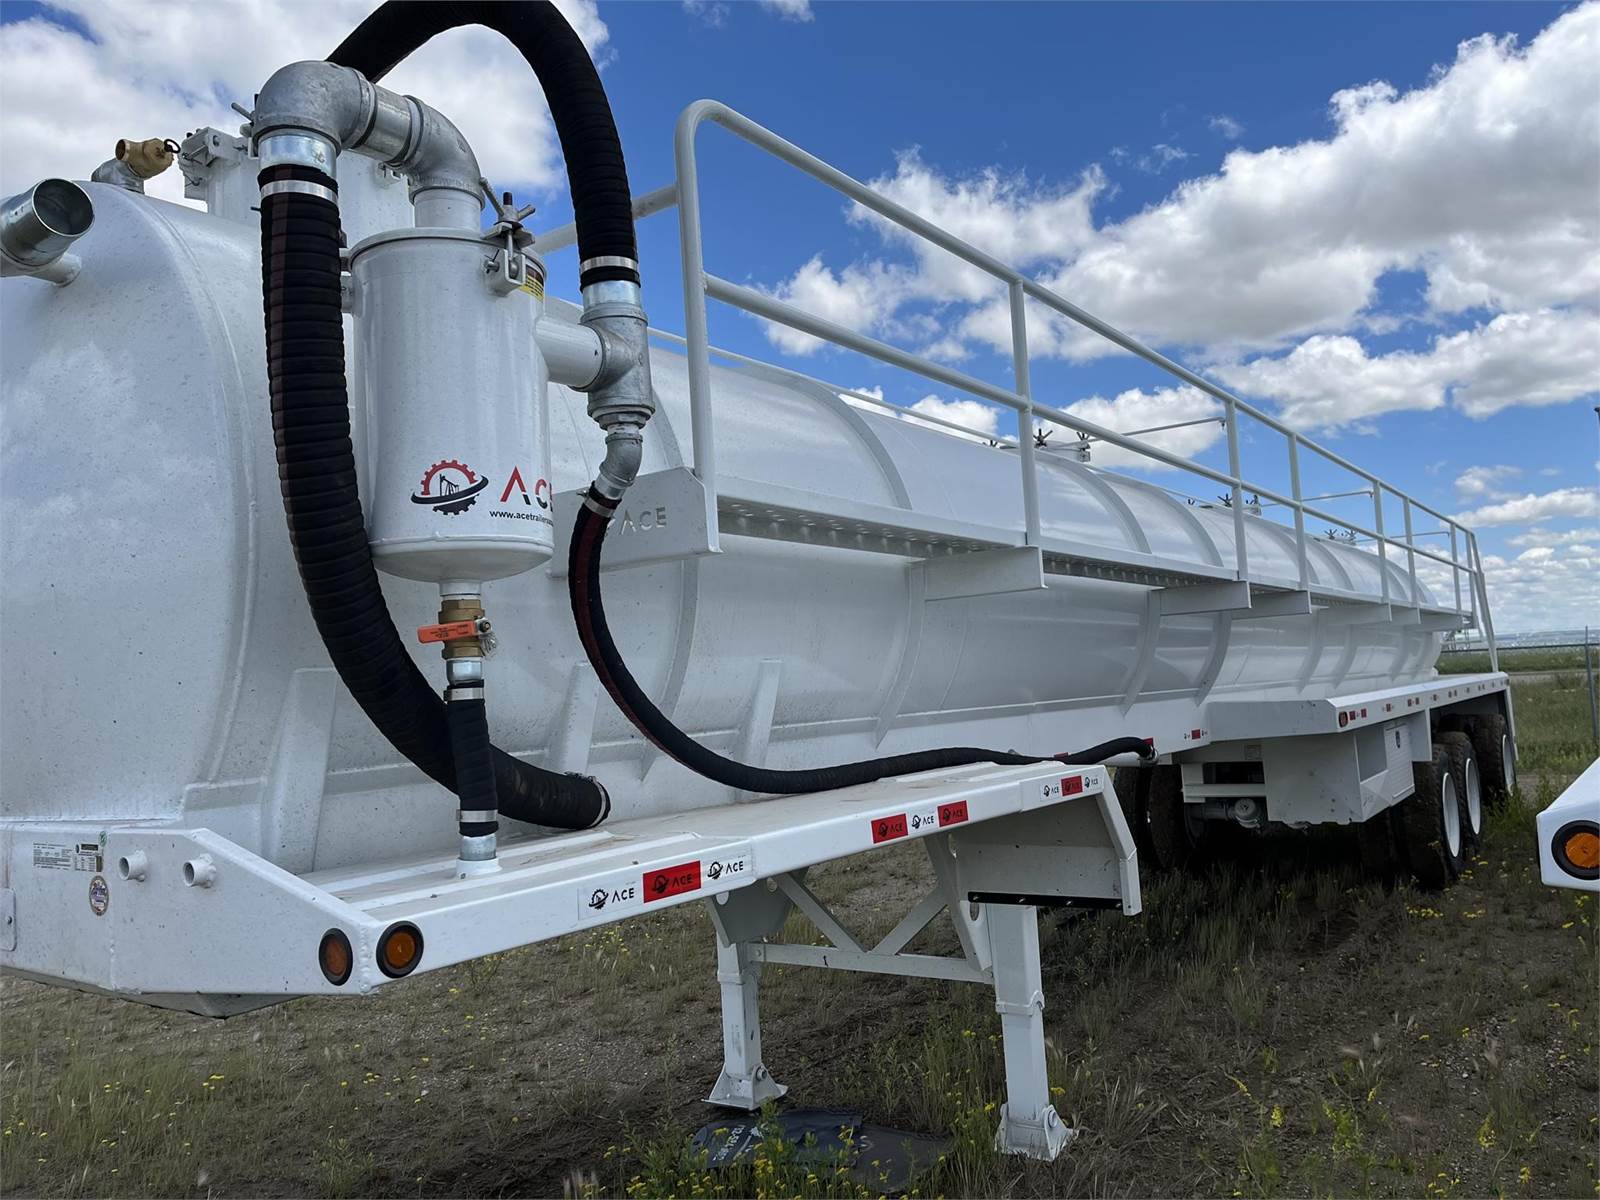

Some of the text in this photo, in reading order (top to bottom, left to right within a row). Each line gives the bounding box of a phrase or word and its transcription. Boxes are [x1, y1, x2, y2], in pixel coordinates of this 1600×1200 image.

[618, 506, 667, 536] ACE
[1050, 786, 1060, 794] ACE
[889, 822, 902, 833] ACE
[922, 815, 935, 826] ACE
[725, 860, 744, 875] ACE
[672, 873, 694, 888] ACE
[611, 887, 635, 904] ACE
